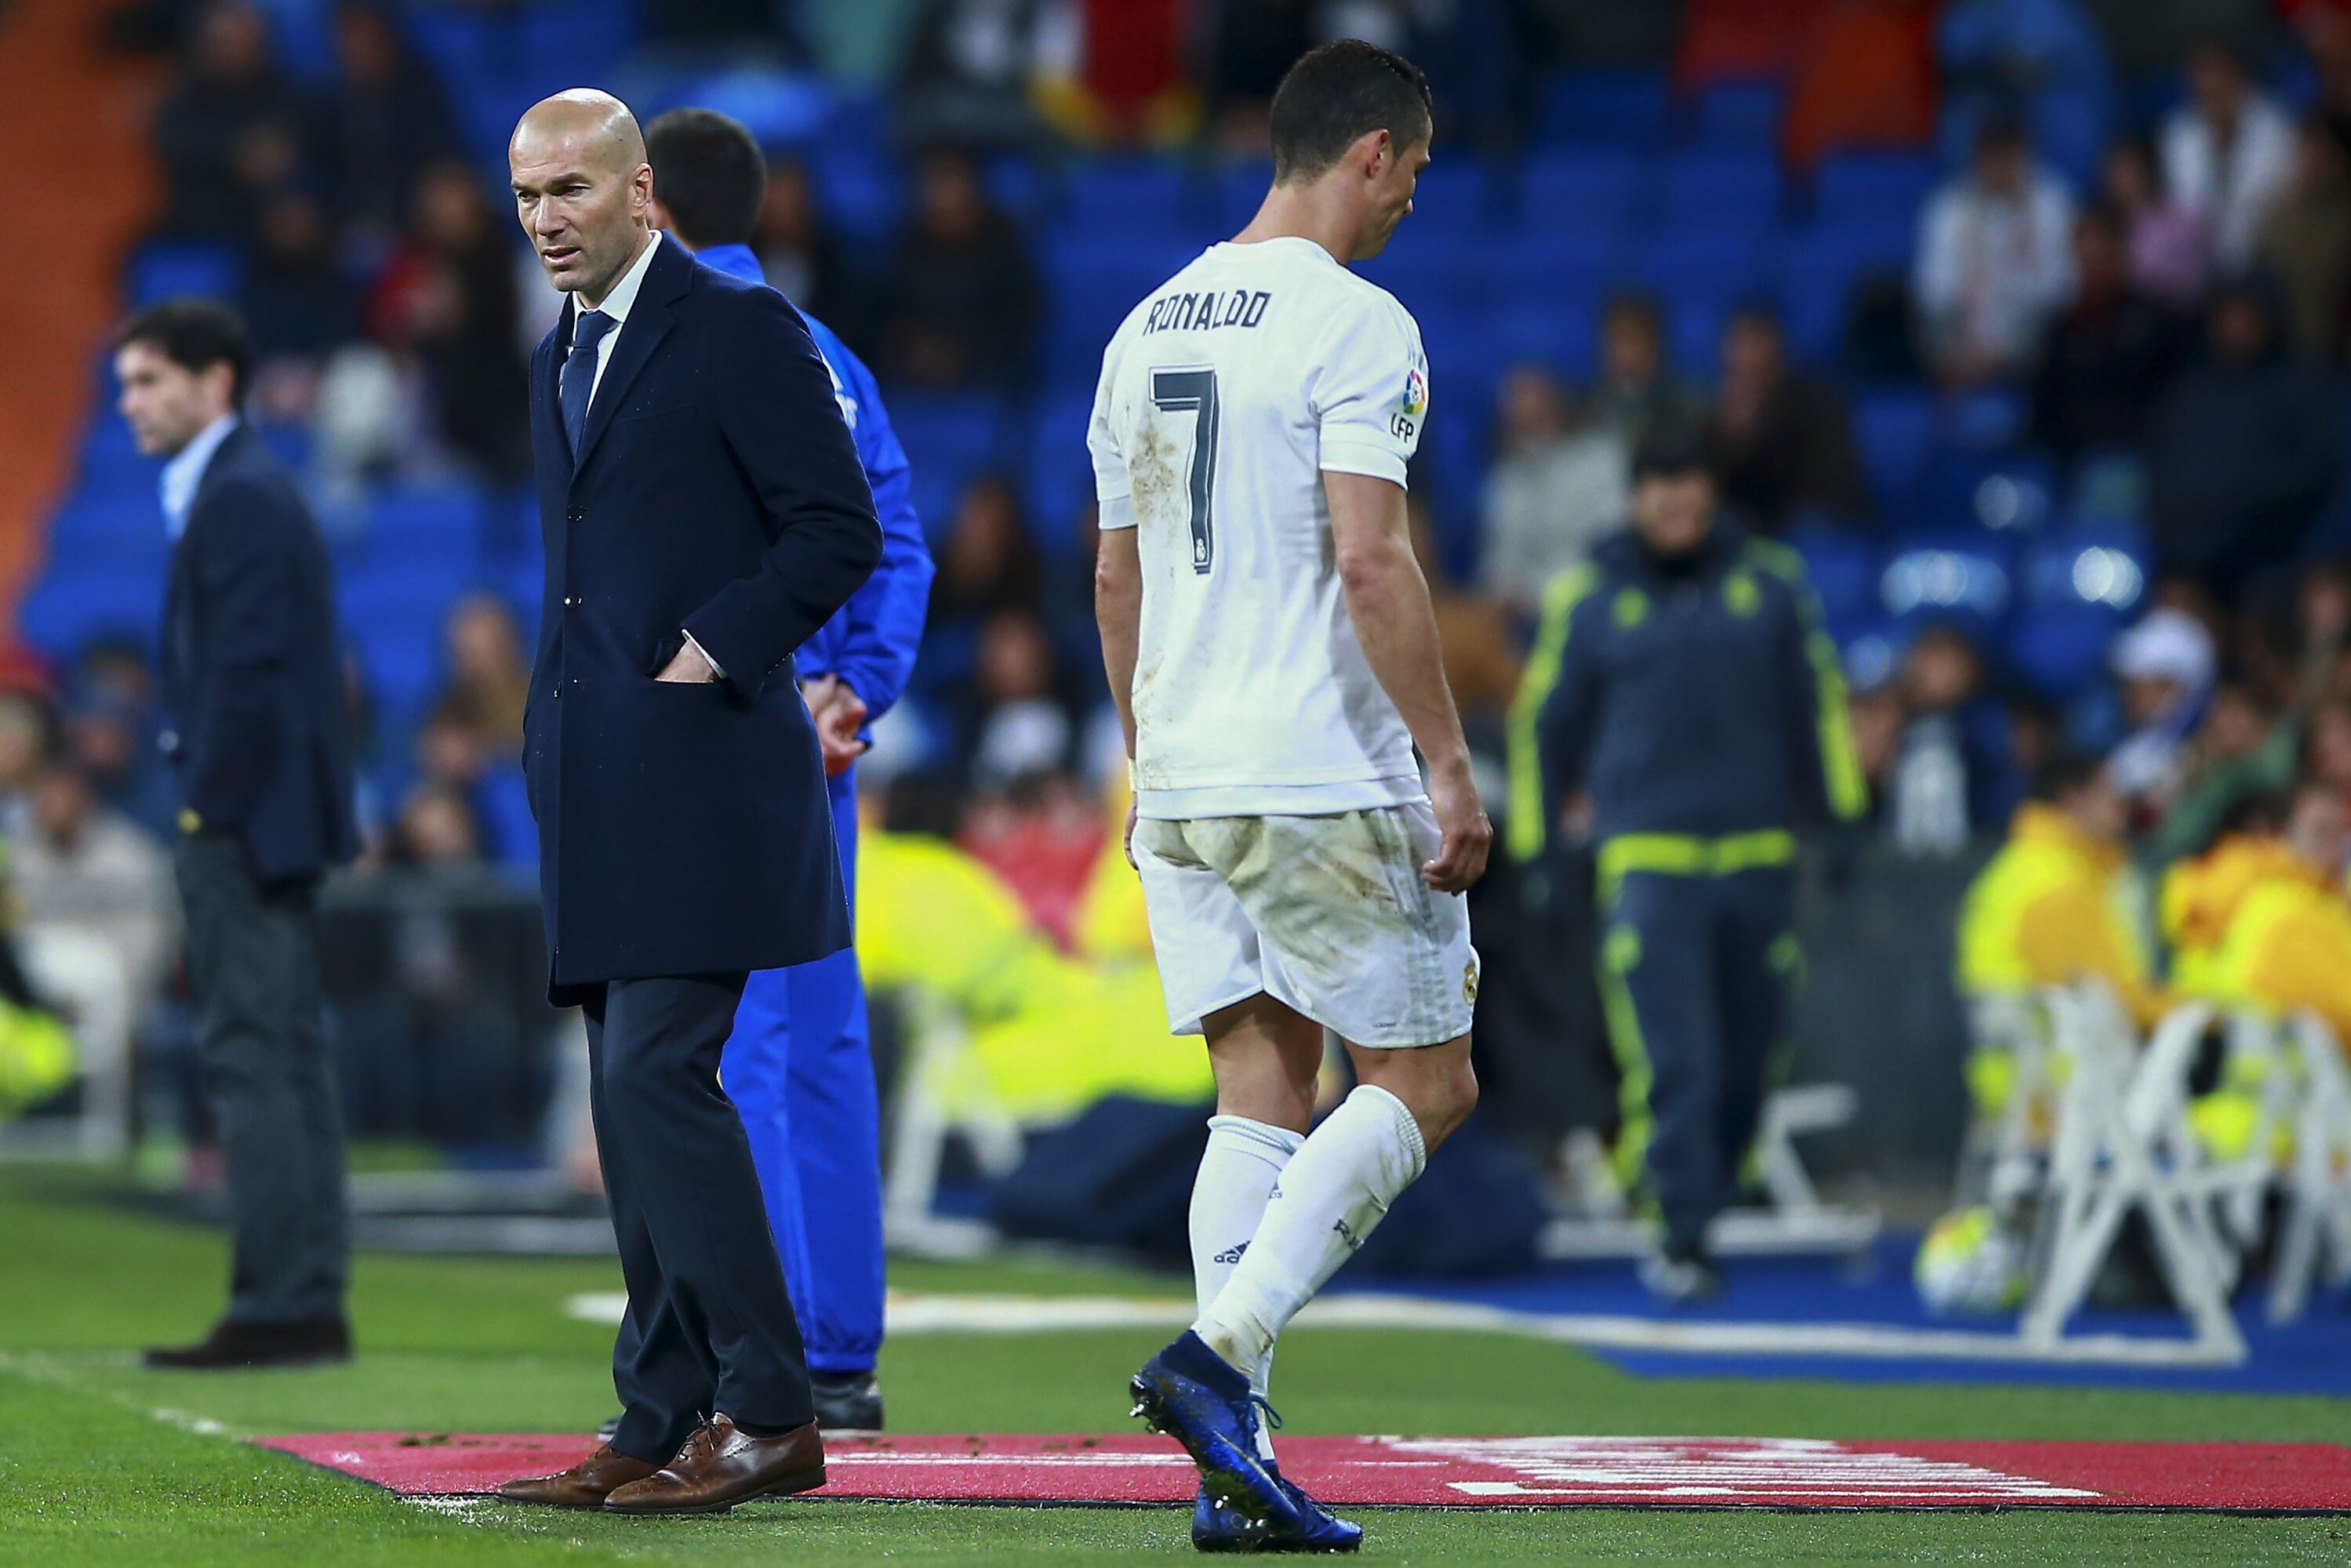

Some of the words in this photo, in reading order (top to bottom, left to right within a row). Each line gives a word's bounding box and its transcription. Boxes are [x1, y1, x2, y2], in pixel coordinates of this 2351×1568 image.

[1142, 289, 1273, 336] RONALDO
[1390, 412, 1415, 444] LFP
[1149, 364, 1219, 575] 7
